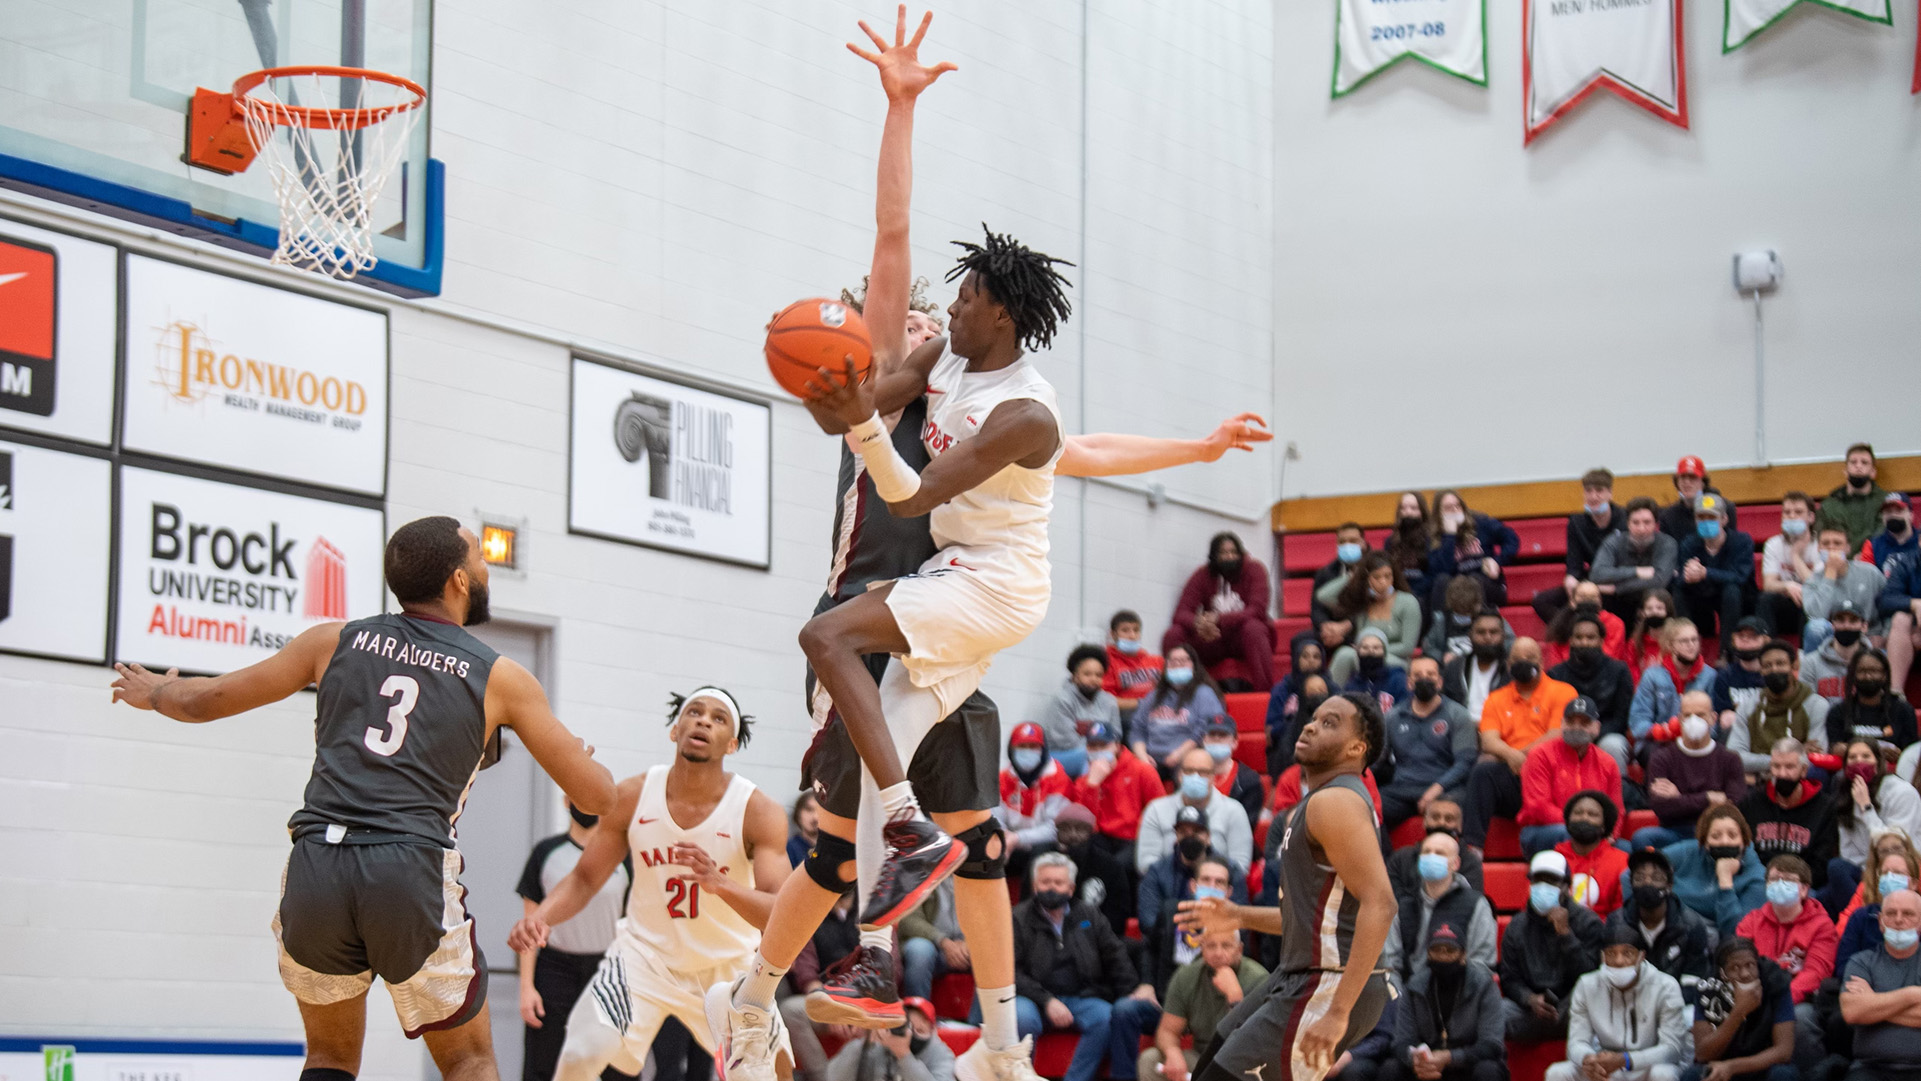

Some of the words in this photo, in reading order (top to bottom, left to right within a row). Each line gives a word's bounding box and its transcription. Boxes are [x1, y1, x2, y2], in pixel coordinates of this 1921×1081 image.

[1370, 21, 1446, 41] 2007-08
[223, 393, 260, 411] WEALTH
[265, 404, 327, 425] MANAGEMENT
[333, 416, 363, 432] GROUP
[676, 400, 733, 469] PILLING
[674, 458, 733, 515] FINANCIAL
[151, 500, 298, 580] Brock
[149, 567, 298, 614] UNIVERSITY
[147, 603, 247, 645] Alumni
[352, 630, 470, 678] MARAUDERS
[363, 673, 420, 757] 3
[666, 877, 699, 919] 21
